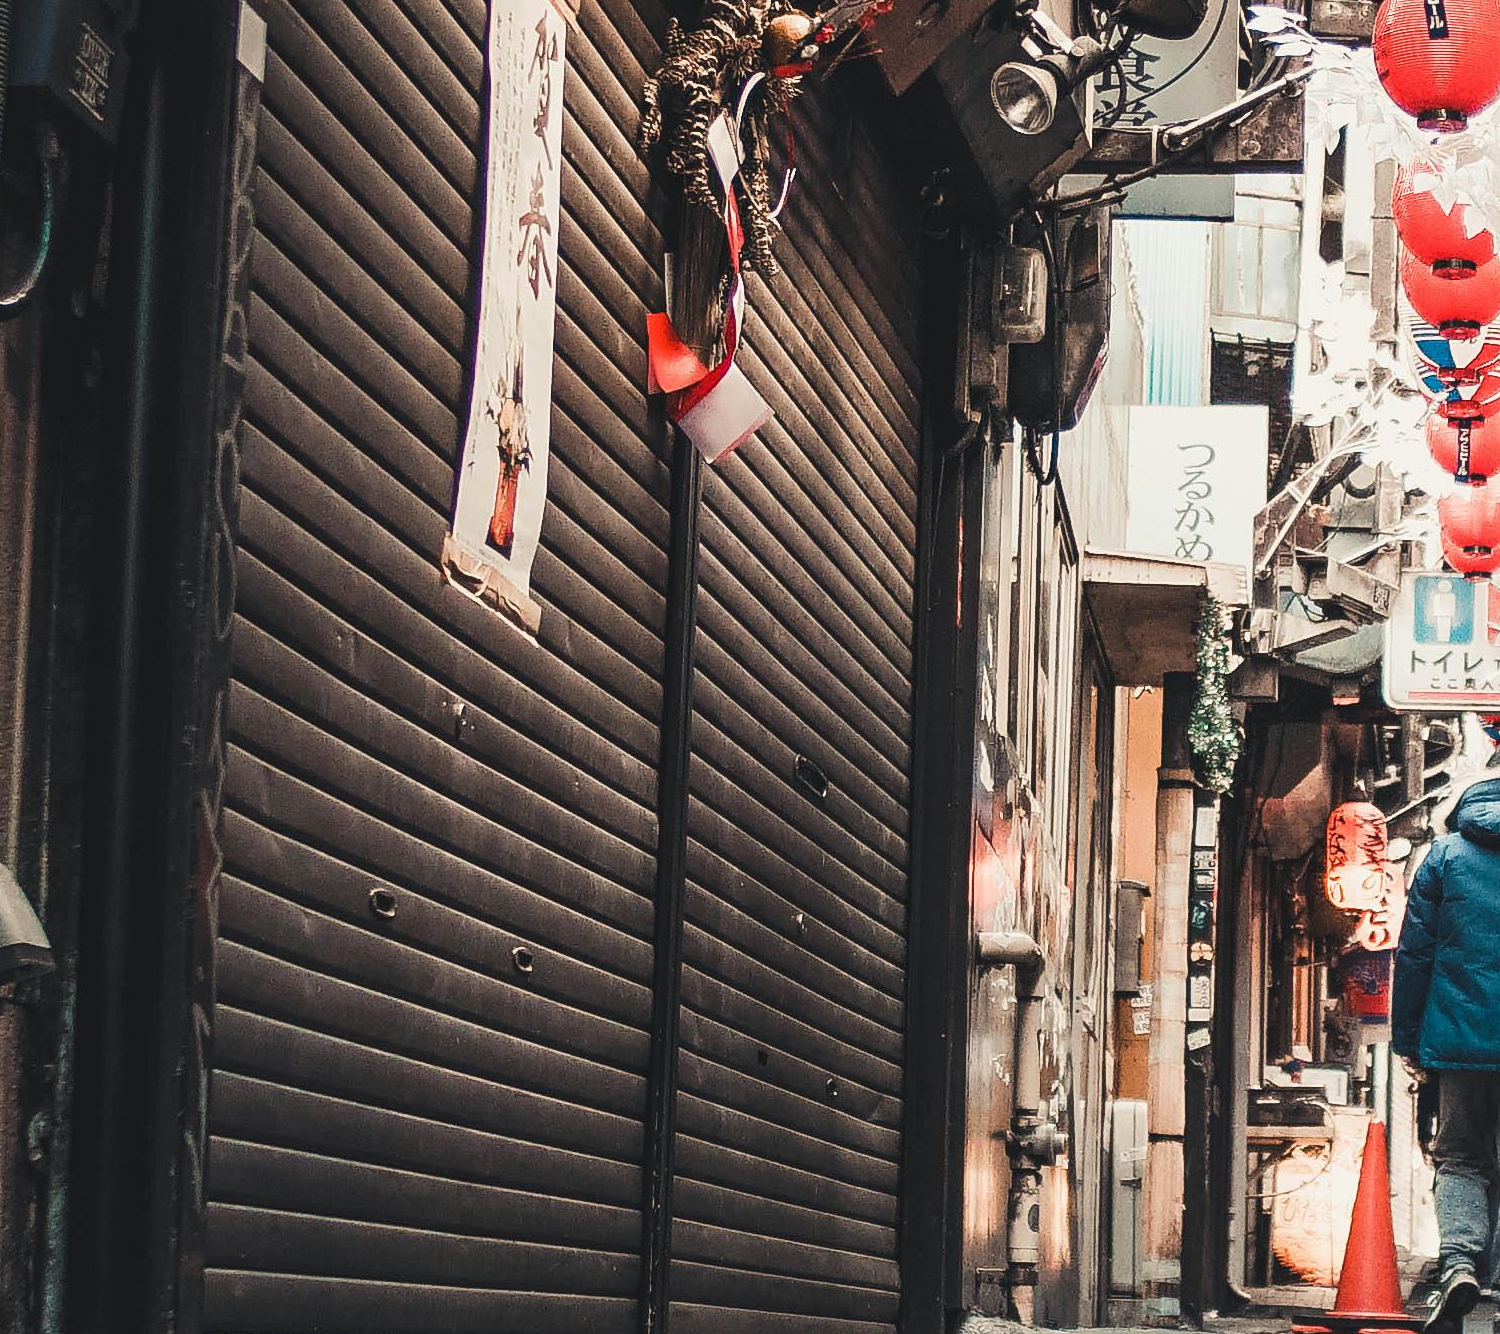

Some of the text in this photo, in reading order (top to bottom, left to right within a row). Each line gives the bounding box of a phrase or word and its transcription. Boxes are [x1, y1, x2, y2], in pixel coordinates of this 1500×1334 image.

[517, 9, 558, 300] 賀春
[1174, 443, 1216, 561] つるかめ
[1411, 650, 1484, 673] トイレ
